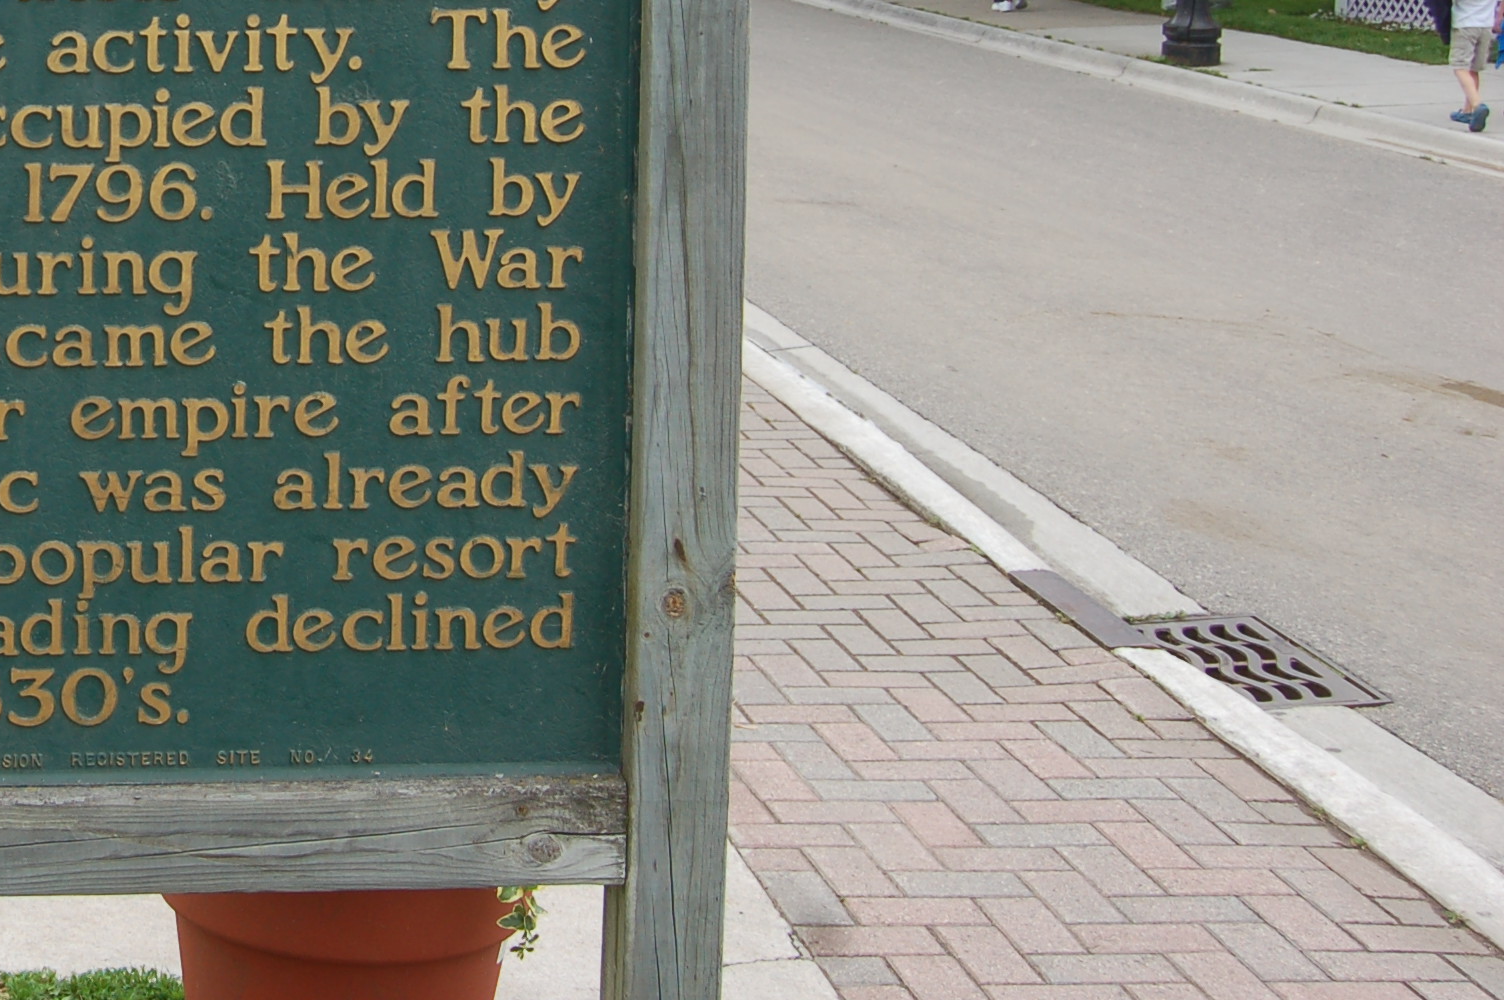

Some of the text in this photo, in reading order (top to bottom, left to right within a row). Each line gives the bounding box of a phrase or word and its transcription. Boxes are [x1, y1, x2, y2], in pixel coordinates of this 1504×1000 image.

[46, 13, 363, 84] activity.
[431, 7, 587, 70] The
[315, 85, 411, 157] by
[461, 84, 586, 144] the
[24, 160, 213, 223] 1796.
[266, 158, 439, 220] Held
[489, 157, 581, 227] by
[248, 232, 376, 293] the
[430, 228, 585, 290] War
[264, 306, 390, 365] the
[436, 301, 581, 363] hub
[70, 383, 340, 457] empire
[389, 375, 582, 436] after
[79, 468, 227, 513] was
[273, 450, 579, 518] already
[333, 523, 577, 581] resort
[245, 592, 575, 653] declined
[70, 750, 191, 768] REGISTERED
[215, 749, 261, 767] SITE
[350, 748, 374, 764] 34
